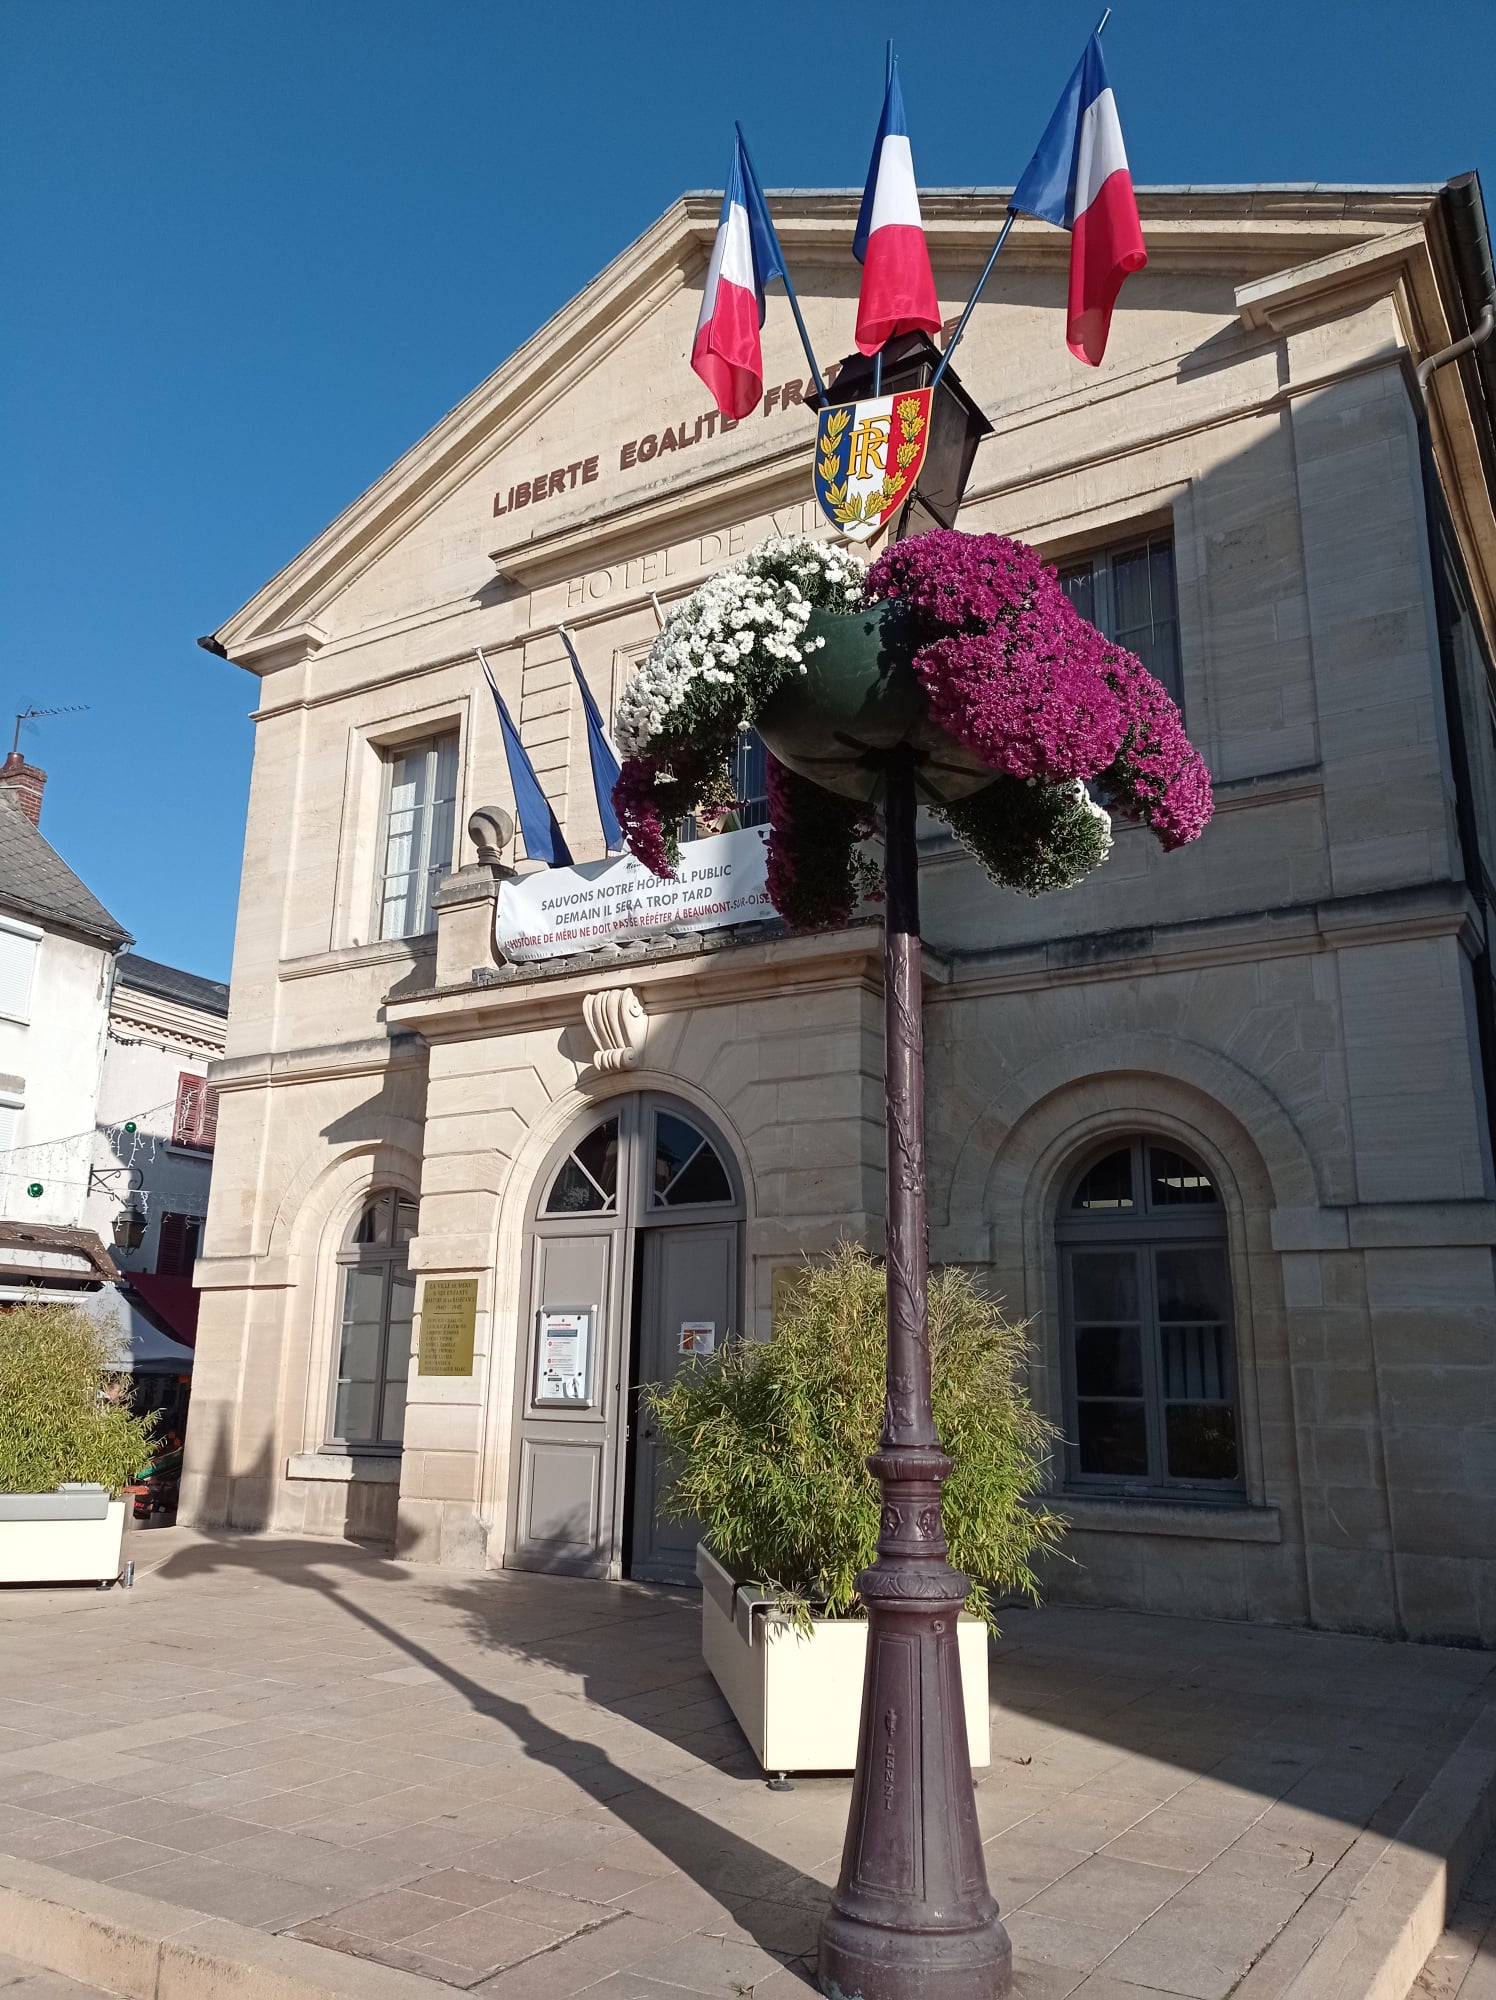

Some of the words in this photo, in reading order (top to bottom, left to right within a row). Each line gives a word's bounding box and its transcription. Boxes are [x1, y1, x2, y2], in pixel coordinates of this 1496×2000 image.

[493, 455, 599, 518] LIBERTE
[566, 549, 676, 608] HOTEL
[698, 524, 746, 566] DE
[541, 890, 594, 911] SAUVONS
[597, 881, 634, 900] NOTRE
[691, 864, 732, 882] PUBLIC
[555, 909, 601, 925] DEMAIN
[603, 905, 612, 917] IL
[615, 899, 643, 914] SERA
[646, 893, 679, 908] TROP
[682, 886, 713, 902] TARD
[544, 933, 554, 944] DE
[555, 928, 577, 942] MÉRU
[579, 926, 591, 938] NE
[592, 922, 611, 936] DOIT
[639, 911, 672, 926] RÉPÉTER
